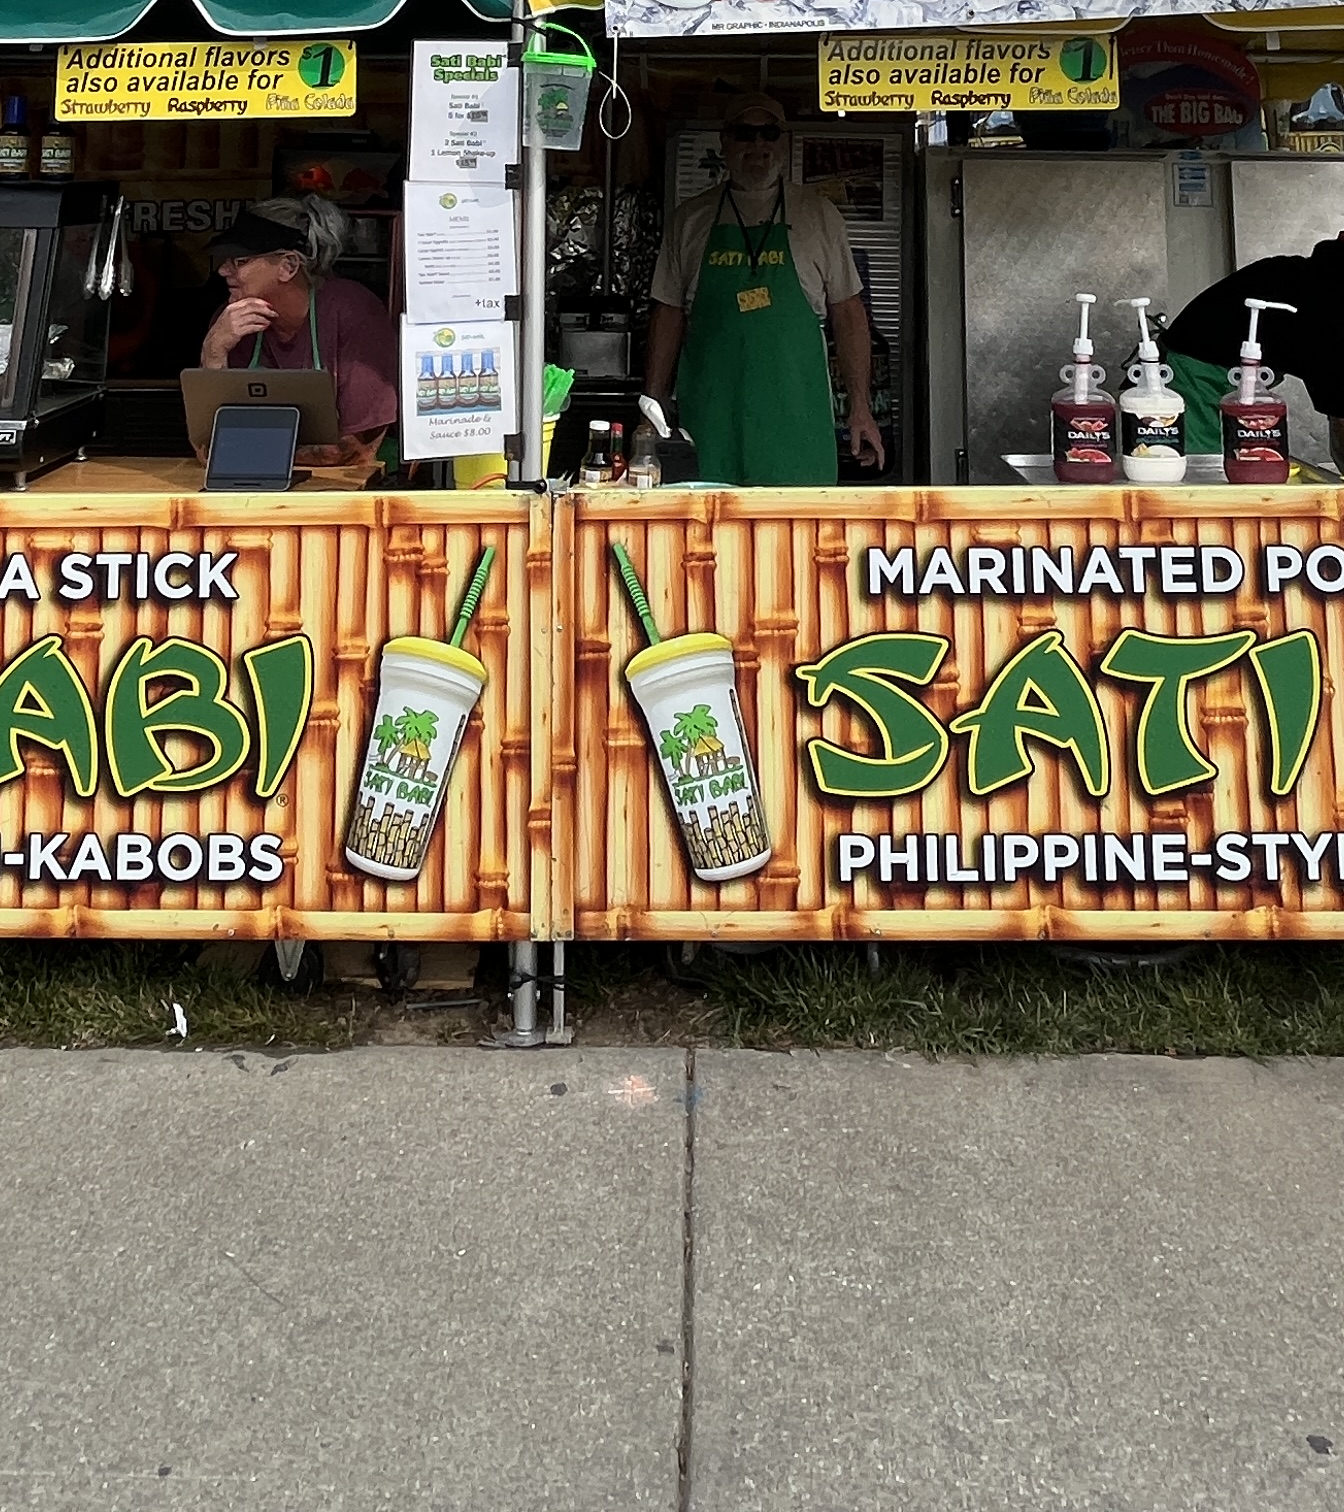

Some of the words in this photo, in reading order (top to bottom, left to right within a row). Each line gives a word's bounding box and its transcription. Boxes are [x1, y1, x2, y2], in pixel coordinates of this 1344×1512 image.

[769, 19, 825, 29] INDIANAPOLIS
[431, 54, 462, 67] Sati
[827, 40, 956, 61] Additional
[965, 39, 1050, 61] flavors
[66, 47, 197, 69] Additional
[205, 46, 290, 68] flavors
[301, 47, 341, 88] $1
[433, 68, 498, 83] Specials
[829, 65, 880, 85] also
[889, 64, 1001, 84] available
[1010, 63, 1046, 83] for
[66, 72, 118, 92] also
[126, 71, 238, 92] available
[248, 70, 283, 90] for
[61, 98, 150, 117] Strawberry
[168, 97, 247, 116] Raspberry
[825, 90, 914, 108] Strawberry
[931, 90, 1011, 108] Raspberry
[1151, 105, 1175, 124] THE
[1180, 101, 1210, 124] BIG
[1214, 104, 1244, 125] BAG
[475, 299, 500, 308] +tax
[429, 414, 481, 426] Marinade
[430, 430, 461, 439] Sauce
[464, 427, 491, 437] $8.00
[59, 551, 239, 600] STICK
[868, 544, 1244, 595] MARINATED
[796, 629, 1321, 796] SATI
